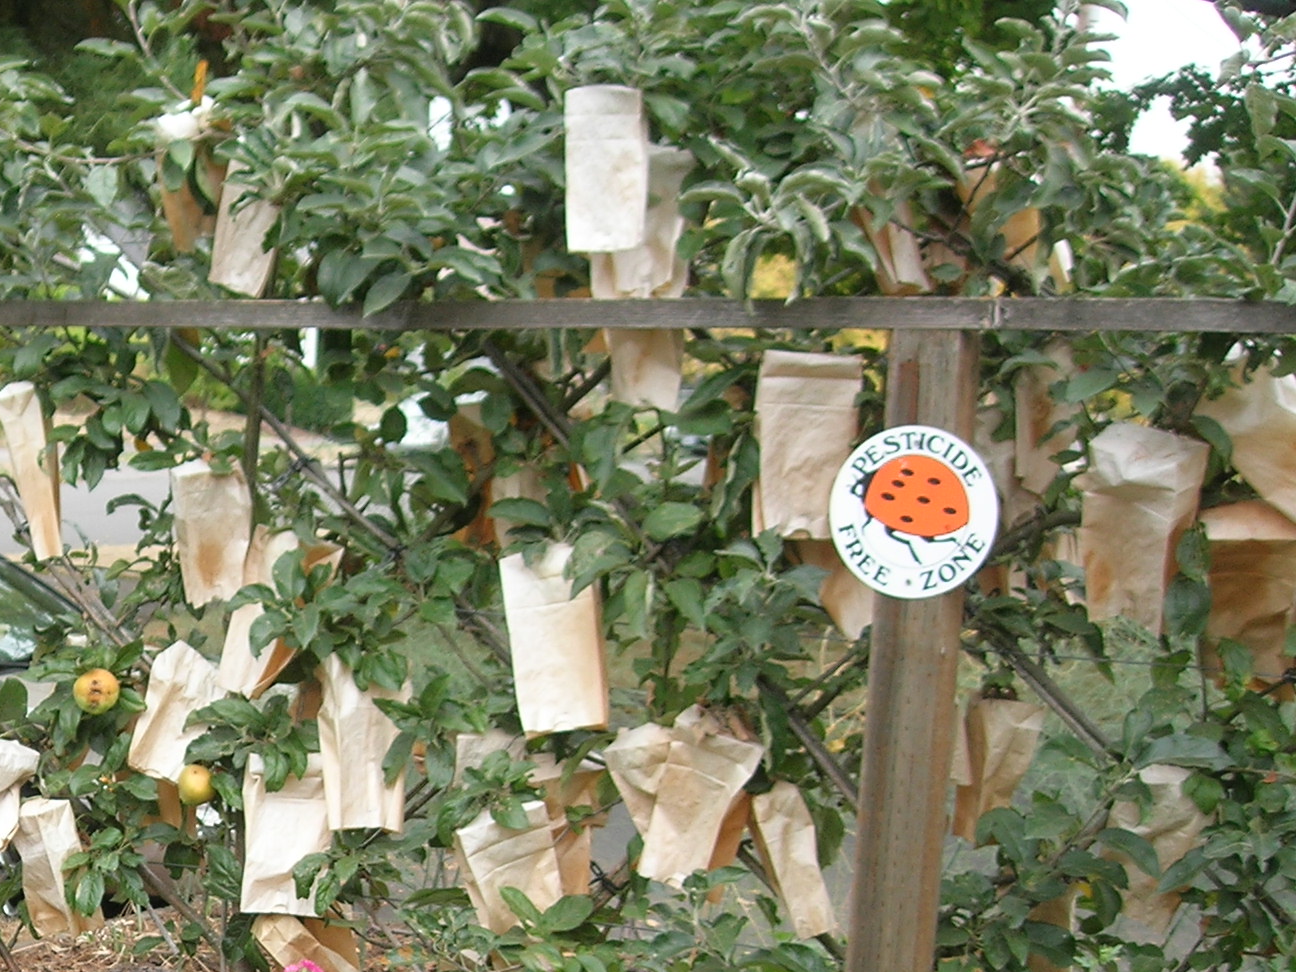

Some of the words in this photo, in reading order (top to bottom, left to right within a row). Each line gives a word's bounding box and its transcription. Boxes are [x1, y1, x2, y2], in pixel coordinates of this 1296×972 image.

[852, 432, 982, 487] PESTICIDE
[838, 524, 891, 586] FREE
[920, 533, 985, 590] ZONE
